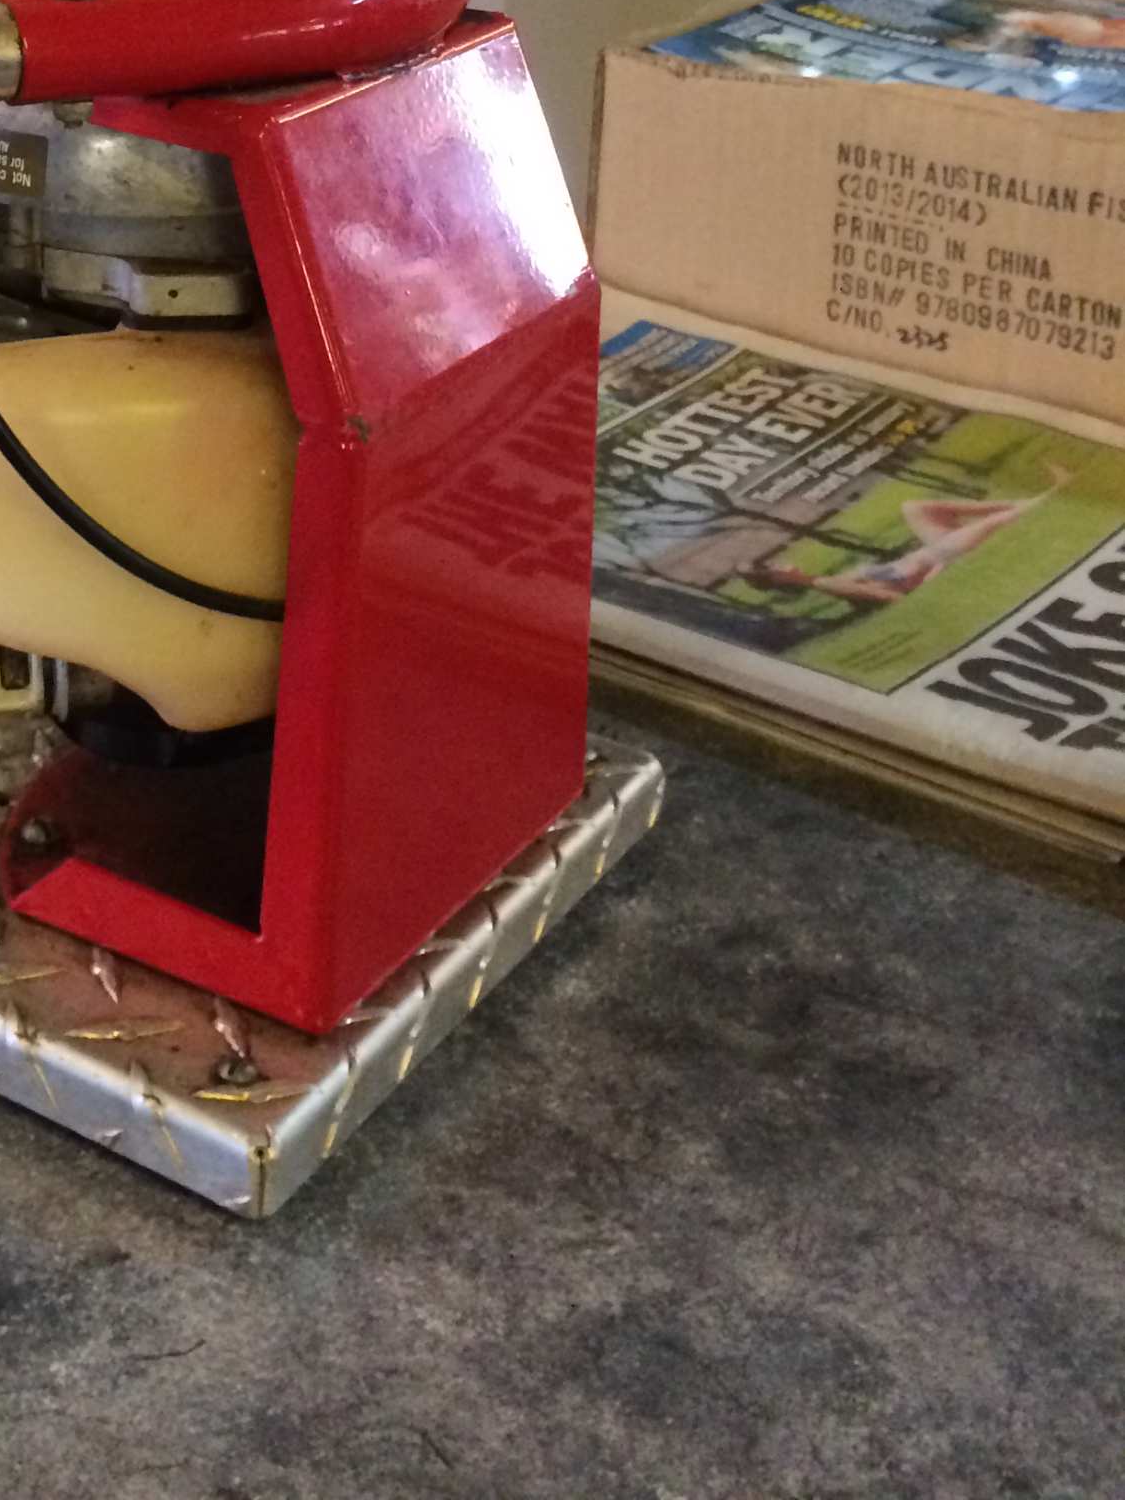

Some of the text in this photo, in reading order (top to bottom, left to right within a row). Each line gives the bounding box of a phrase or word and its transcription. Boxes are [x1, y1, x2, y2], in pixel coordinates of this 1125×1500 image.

[10, 157, 25, 171] for
[12, 171, 31, 187] Not
[837, 143, 915, 180] NORTH
[924, 161, 1078, 214] AUSTRALIAN
[838, 173, 988, 226] (2013/2014)
[834, 212, 1052, 281] PRINTED IN CHINA
[832, 273, 1115, 361] ISBN# 9780987079213
[833, 243, 1123, 330] 10 COPIES PER CARTON
[612, 368, 797, 469] HOTTEST
[673, 433, 778, 491] DAY
[744, 380, 871, 443] EVER
